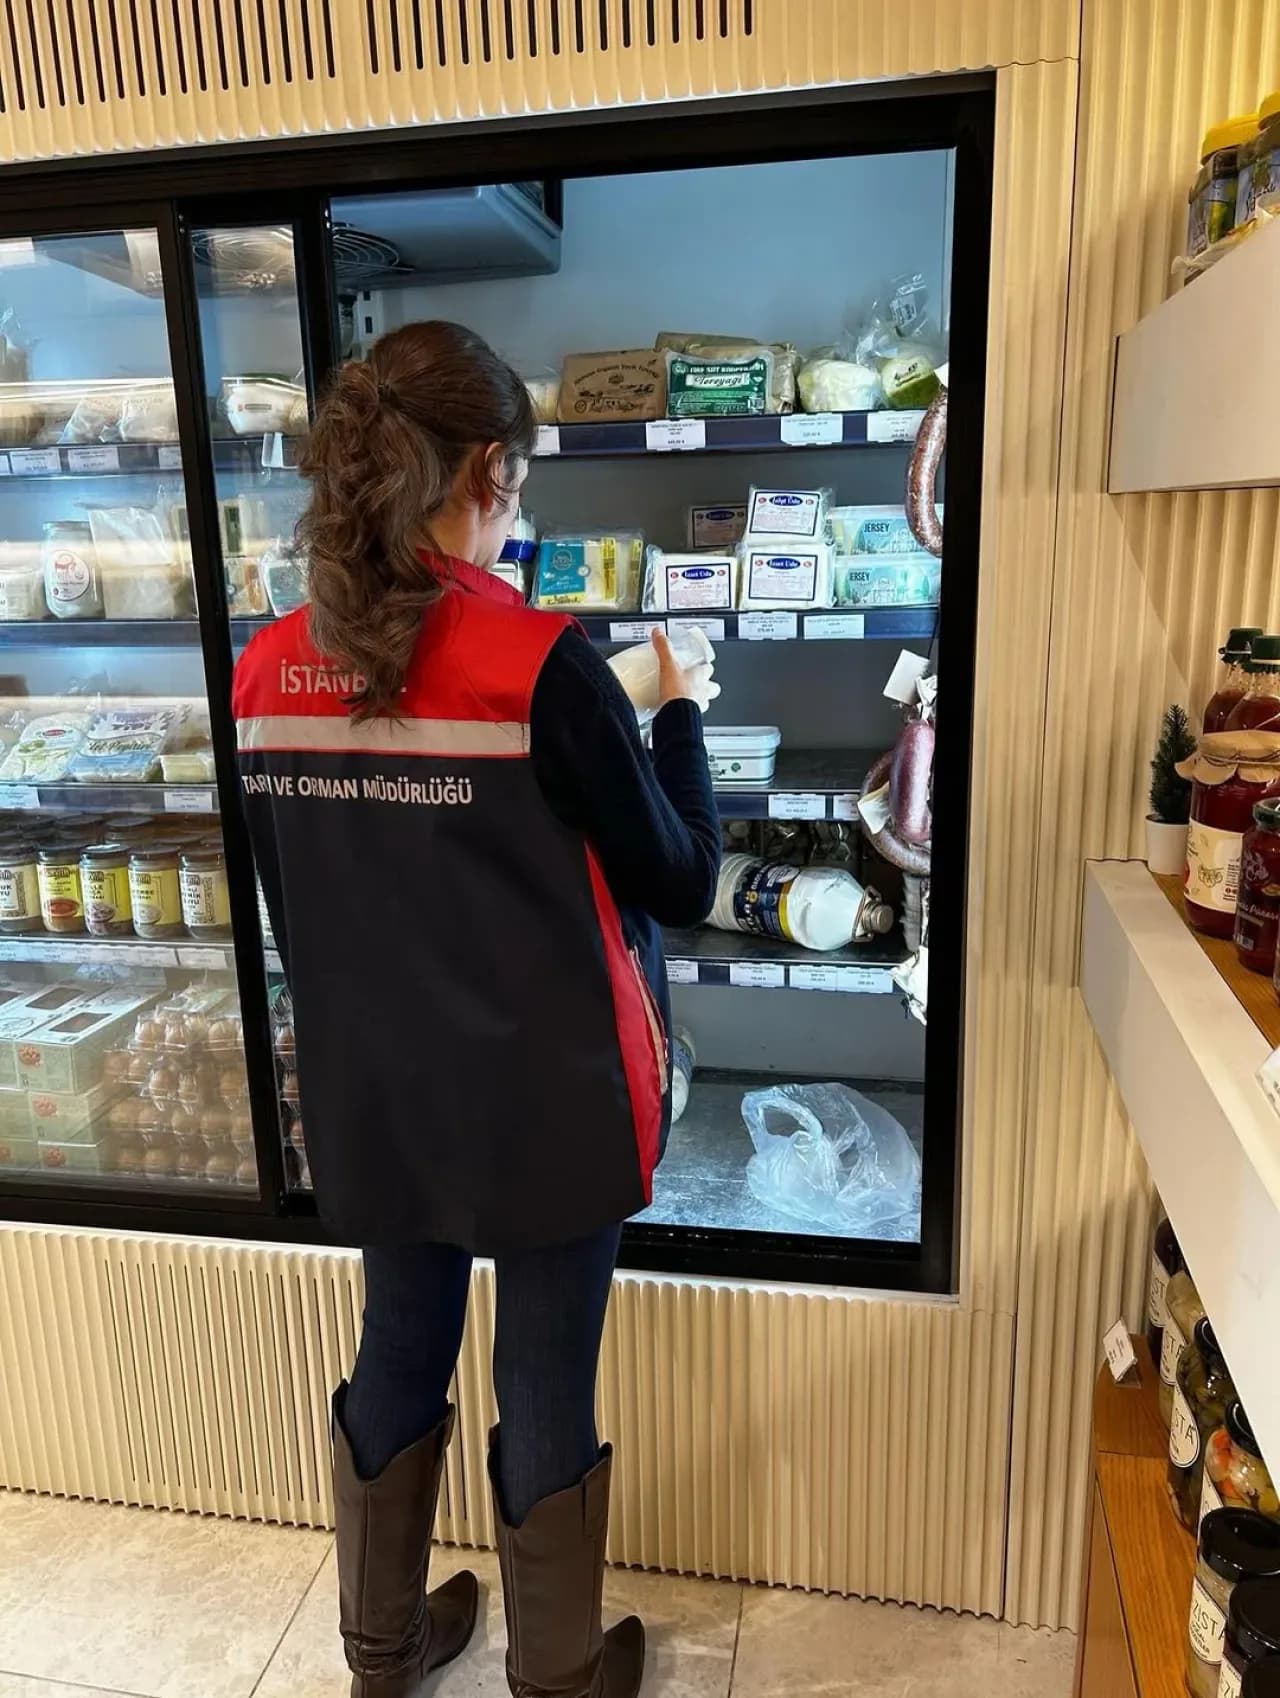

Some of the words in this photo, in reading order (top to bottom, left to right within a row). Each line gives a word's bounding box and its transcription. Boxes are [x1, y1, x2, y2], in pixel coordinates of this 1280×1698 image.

[863, 523, 891, 534] JERSEY
[849, 571, 871, 582] JERSEY
[273, 776, 295, 797] VE
[297, 776, 359, 800] ORMAN
[362, 776, 473, 805] MÜDÜRLÜĞÜ
